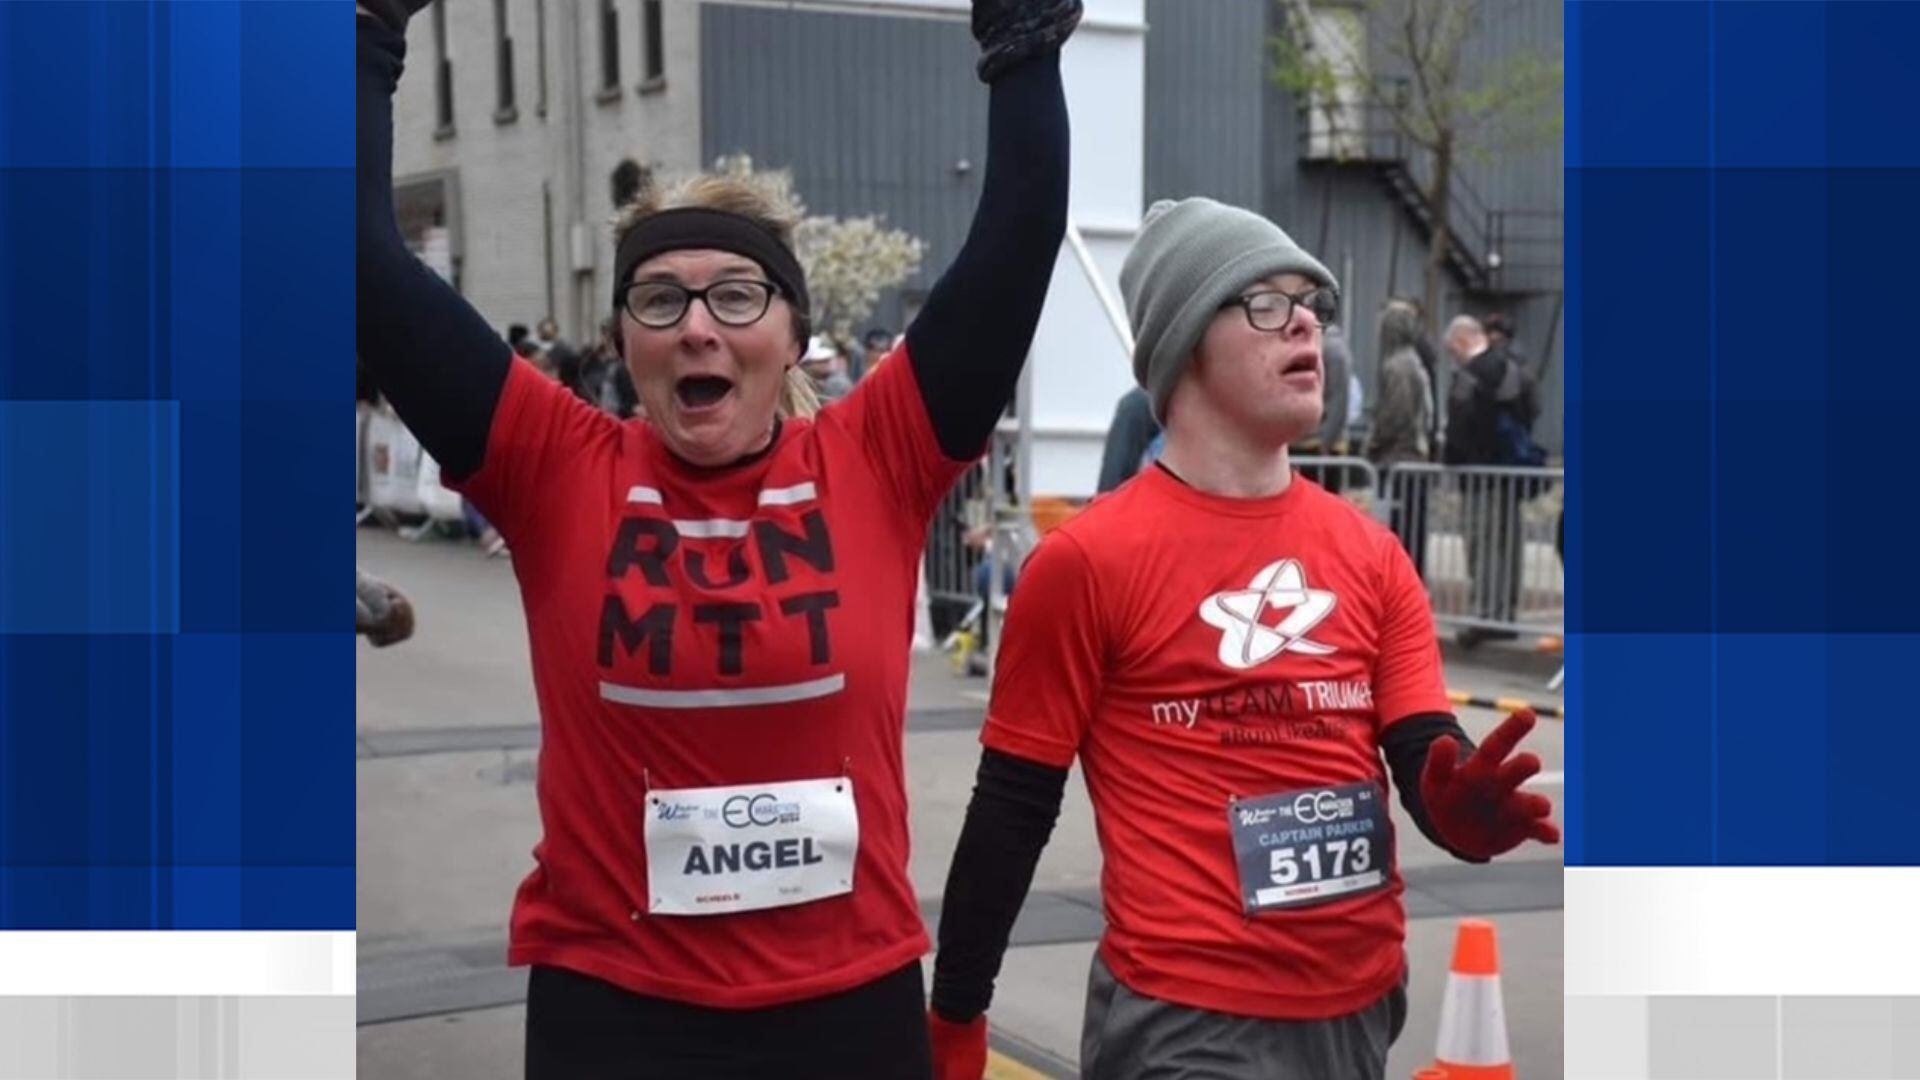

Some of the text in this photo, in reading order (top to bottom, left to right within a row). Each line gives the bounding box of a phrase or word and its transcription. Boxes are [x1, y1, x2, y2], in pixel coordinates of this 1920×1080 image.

[606, 508, 835, 588] RUN
[597, 590, 841, 677] MTT
[722, 793, 779, 828] EC
[1294, 790, 1337, 823] EC
[1259, 818, 1375, 847] CAPTAIN PARKER
[683, 837, 823, 875] ANGEL
[1270, 837, 1372, 885] 5173
